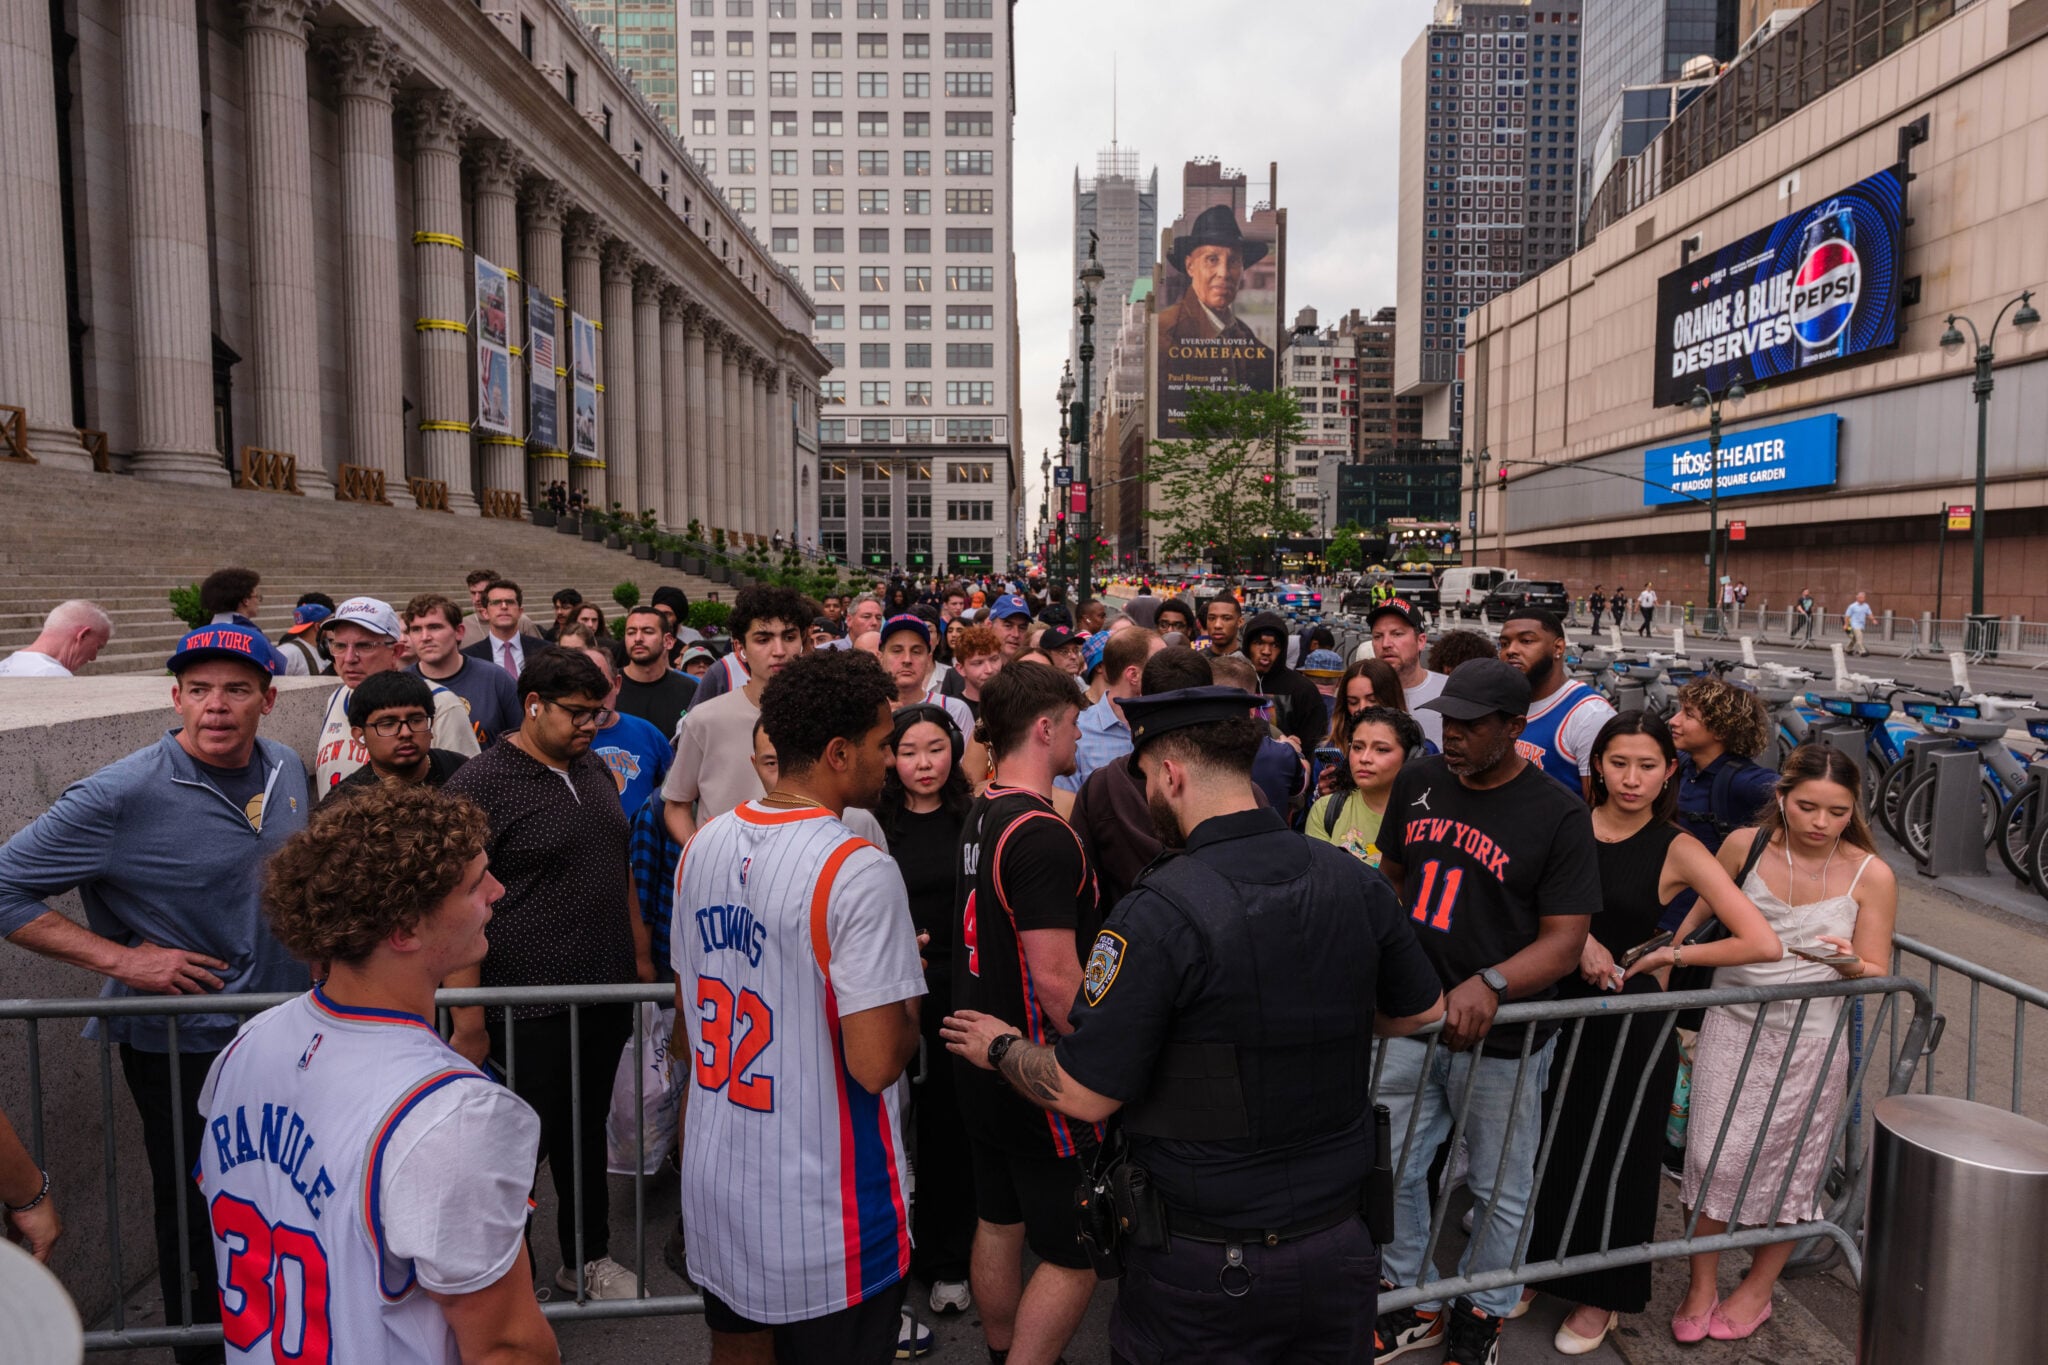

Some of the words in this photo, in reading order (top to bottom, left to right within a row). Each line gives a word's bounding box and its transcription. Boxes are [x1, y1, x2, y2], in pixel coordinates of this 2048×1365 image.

[1674, 293, 1732, 350] ORANGE
[1732, 290, 1747, 327] &
[1748, 269, 1793, 321] BLUE
[1793, 273, 1854, 312] PEPSI
[1168, 346, 1267, 359] COMEBACK
[1223, 338, 1247, 346] LOVES
[1672, 314, 1792, 378] DESERVES
[1168, 373, 1184, 381] Paul
[1209, 375, 1222, 383] got
[1672, 451, 1712, 476] Infosys
[1716, 439, 1785, 469] THEATER
[1671, 482, 1680, 493] AT
[1716, 473, 1748, 488] SQUARE
[1749, 468, 1785, 483] GARDEN
[338, 604, 376, 619] Knicks
[186, 631, 215, 651] NEW
[216, 631, 254, 654] YORK
[316, 740, 345, 768] NEW
[1405, 818, 1453, 846] NEW
[1452, 822, 1511, 882] YORK
[1411, 858, 1465, 933] 11
[695, 904, 768, 969] TOWNS
[1104, 964, 1118, 984] YORK
[695, 974, 775, 1114] 32
[211, 1102, 338, 1220] RANDLE
[210, 1189, 334, 1365] 30
